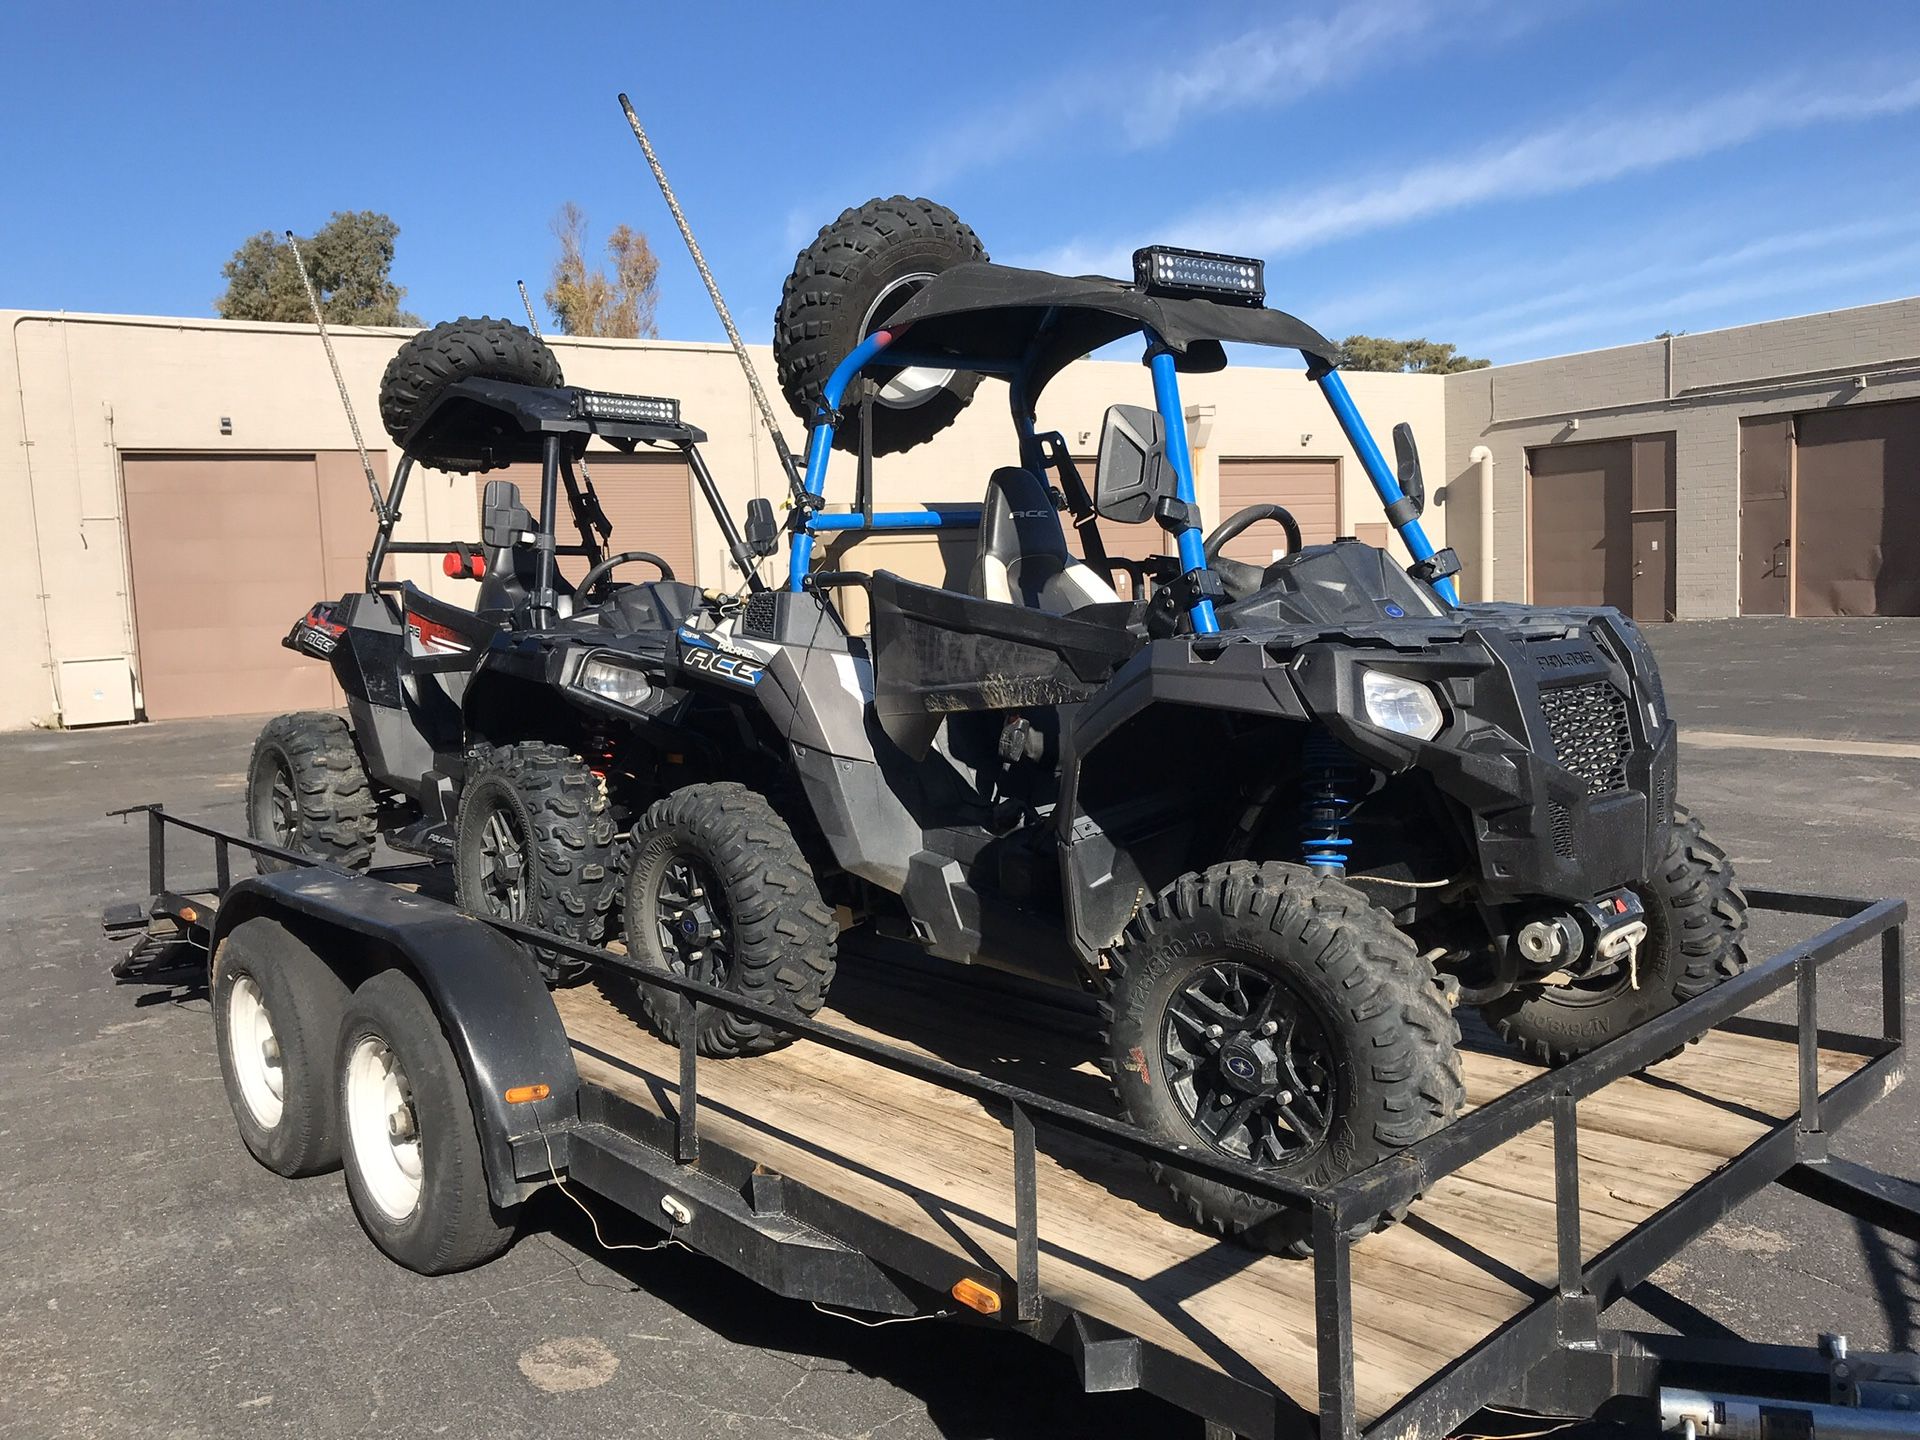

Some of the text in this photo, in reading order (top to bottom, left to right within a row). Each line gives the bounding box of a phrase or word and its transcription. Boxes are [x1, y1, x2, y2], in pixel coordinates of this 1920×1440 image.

[1009, 510, 1048, 518] ACE
[304, 631, 337, 653] ACE
[717, 642, 755, 658] POLARIS
[684, 647, 766, 684] ACE
[1536, 651, 1595, 671] POLARIS
[632, 834, 679, 911] COMMANDER
